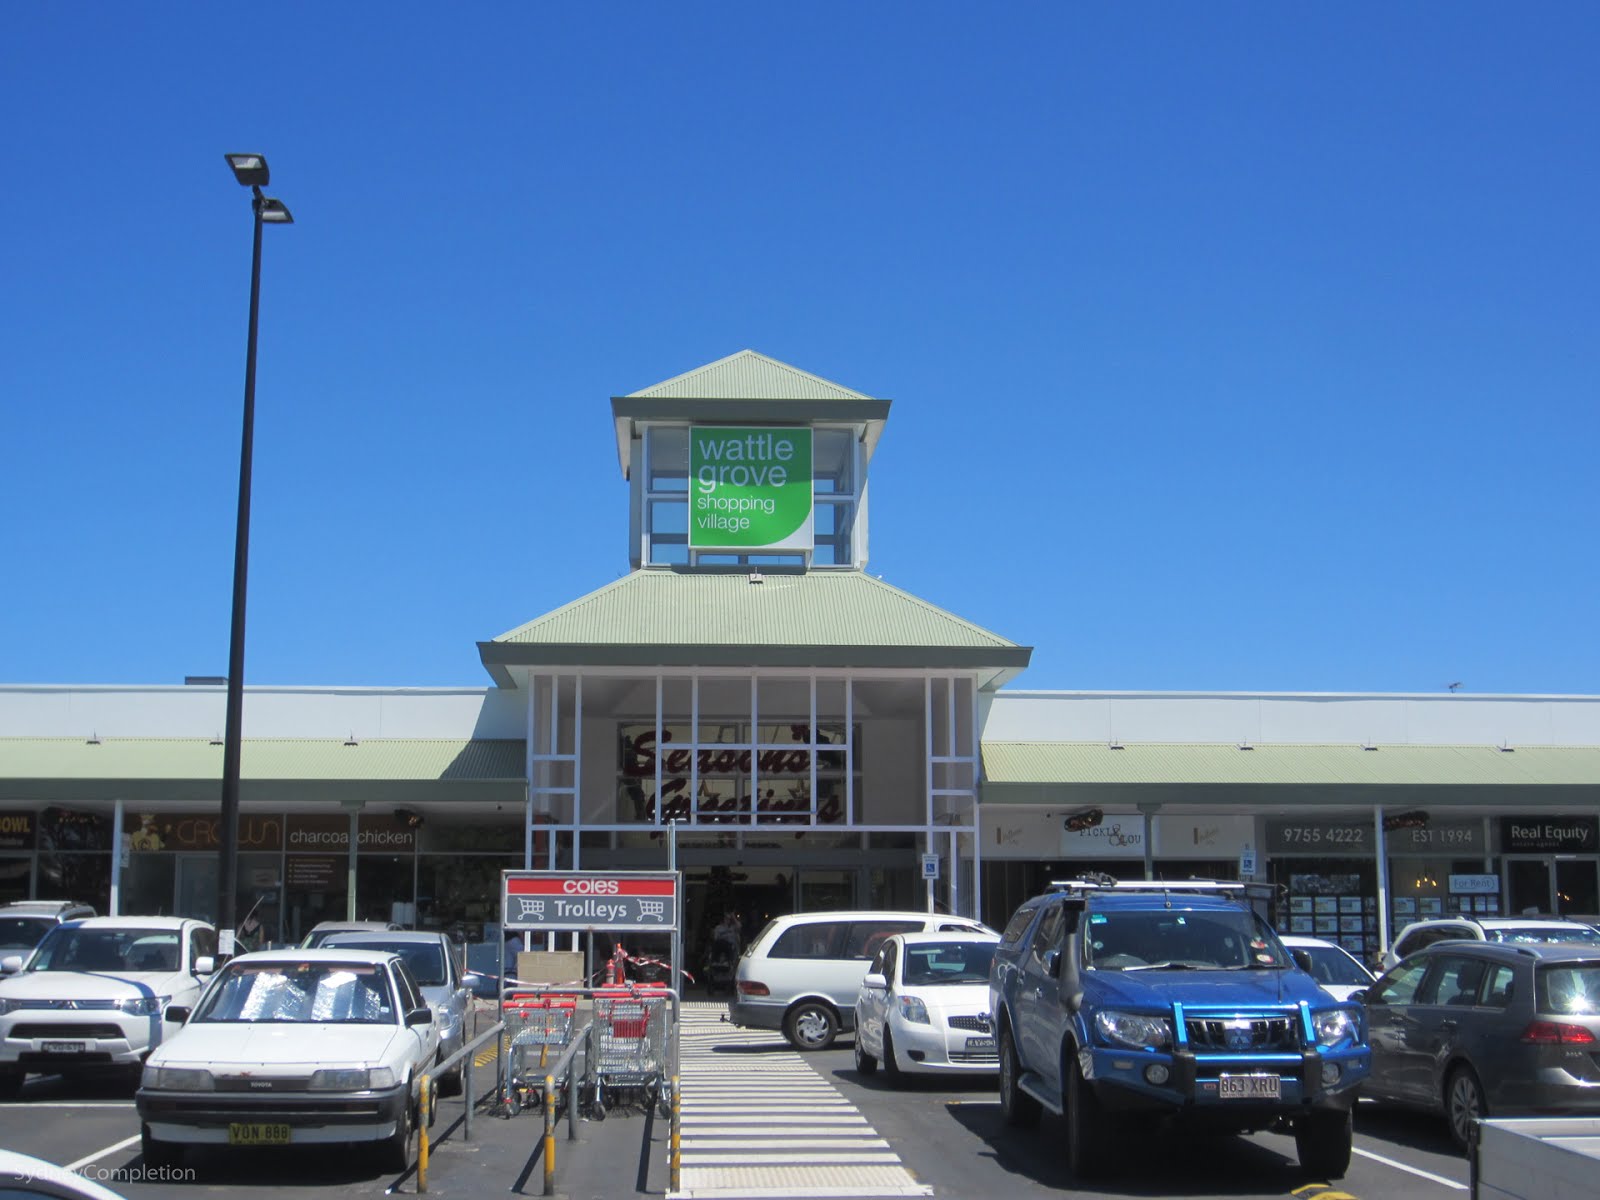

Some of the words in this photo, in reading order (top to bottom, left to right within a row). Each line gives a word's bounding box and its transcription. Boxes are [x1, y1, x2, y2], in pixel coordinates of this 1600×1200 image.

[699, 434, 794, 460] wattle
[698, 465, 787, 493] grove
[697, 494, 775, 514] shopping
[697, 514, 750, 533] village
[0, 816, 30, 832] OWL
[290, 829, 349, 844] charcoa
[356, 829, 413, 844] chicken
[1284, 828, 1321, 842] 9755
[1325, 828, 1363, 842] 4222
[1412, 829, 1434, 842] EST
[1439, 829, 1472, 842] 1994
[1511, 825, 1541, 838] Real
[1545, 825, 1588, 842] Equity
[563, 880, 619, 894] coles
[554, 900, 627, 921] Trolleys
[1221, 1078, 1244, 1092] 863
[1250, 1078, 1278, 1092] XRU
